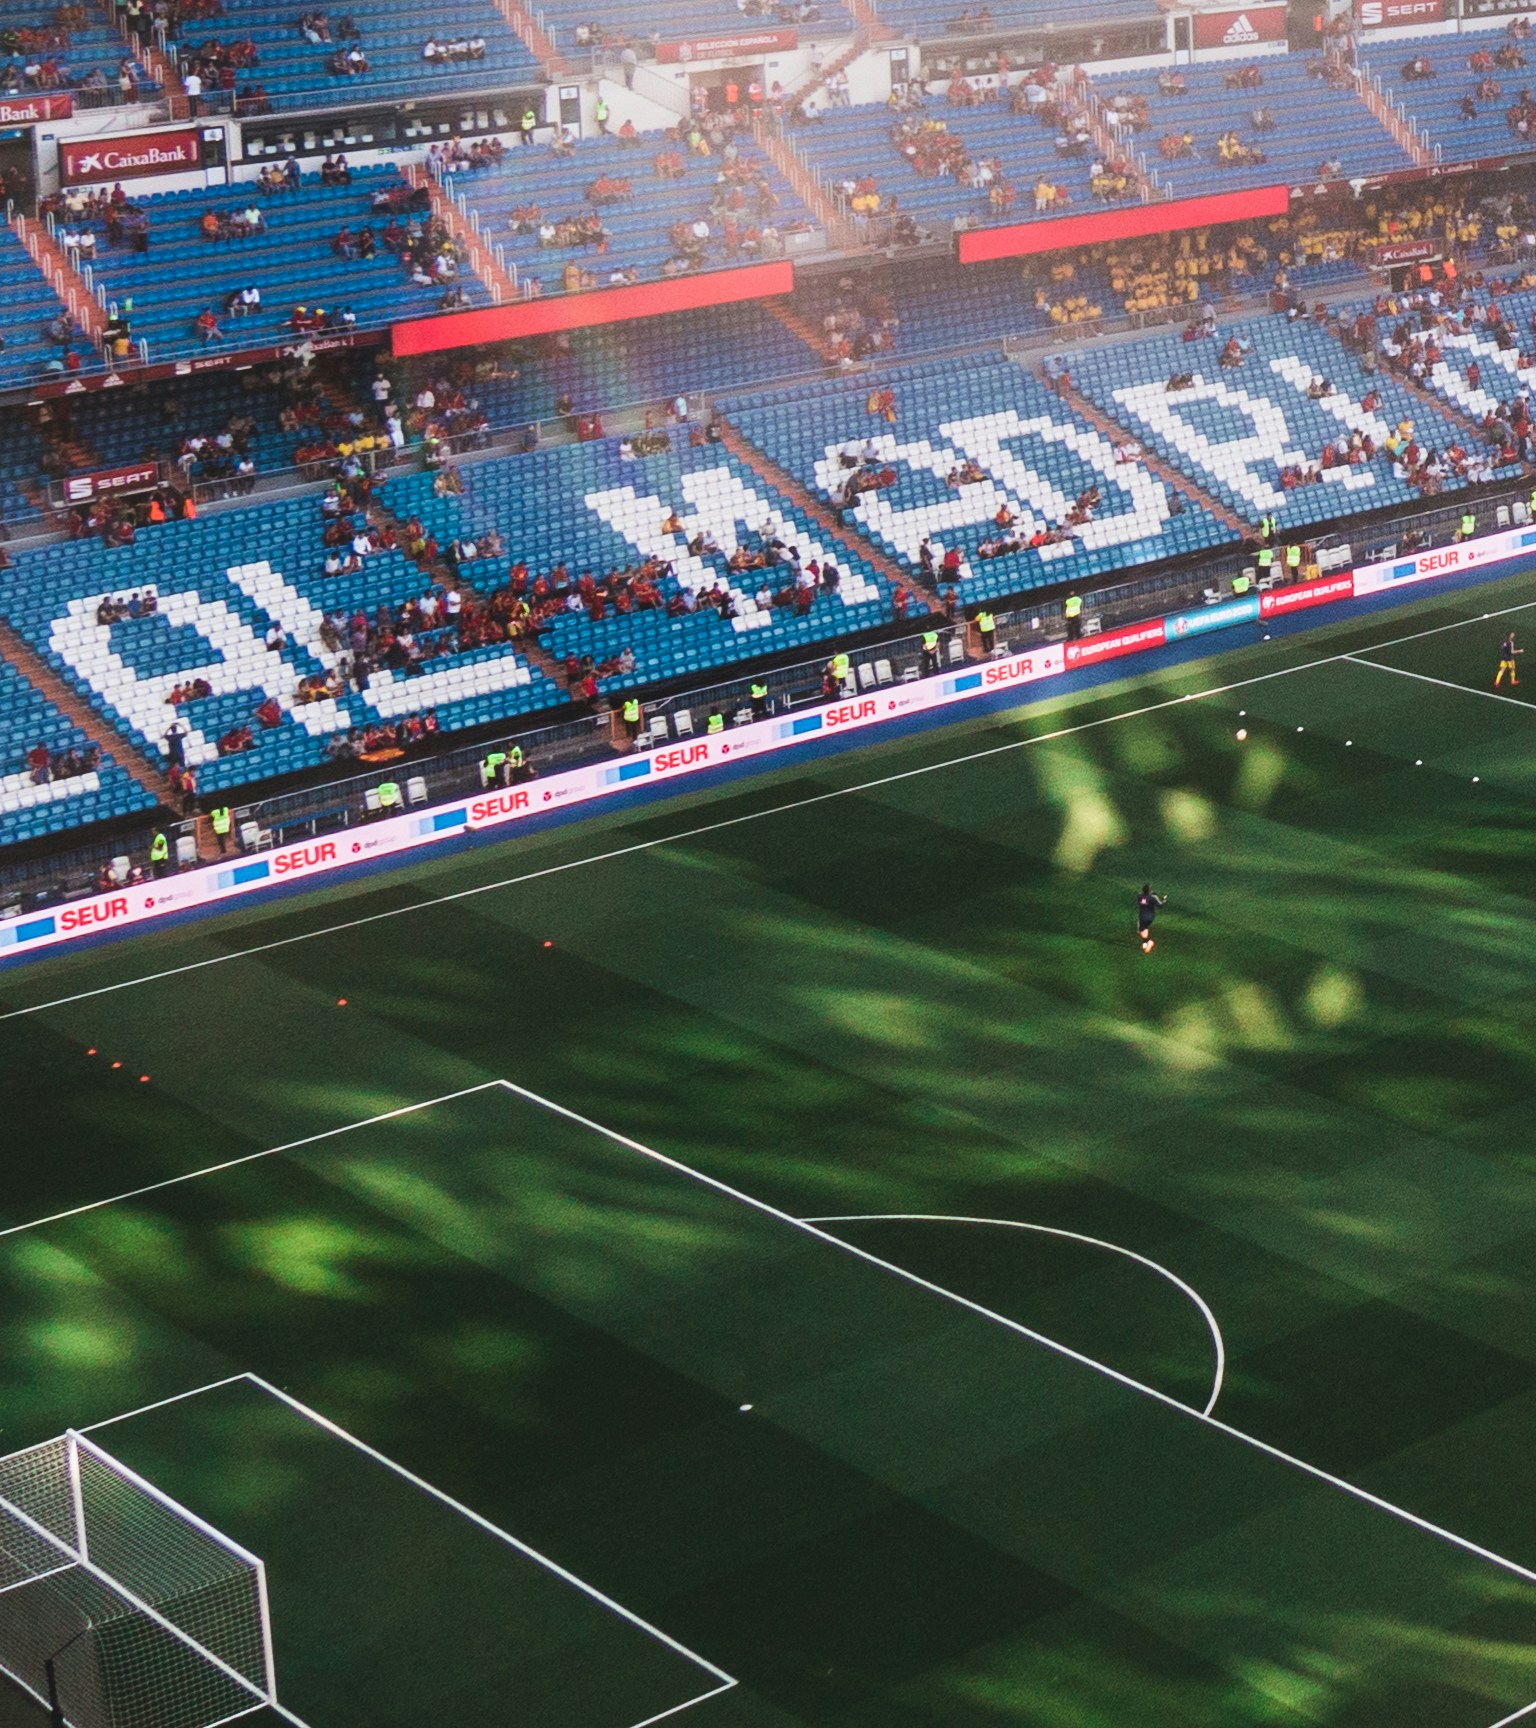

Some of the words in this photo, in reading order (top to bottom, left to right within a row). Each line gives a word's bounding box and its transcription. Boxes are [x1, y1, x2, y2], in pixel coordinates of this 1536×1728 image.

[1387, 2, 1438, 17] SEAT
[1223, 31, 1259, 44] adidas
[104, 145, 186, 169] CaixaBank
[195, 356, 232, 369] SEAT
[97, 470, 154, 490] SEAT
[1419, 551, 1459, 573] SEUR
[1276, 589, 1313, 606] EUROPEAN
[1313, 579, 1352, 597] QUALIFIERS
[1081, 638, 1121, 658] EUROPEAN
[1122, 627, 1164, 647] QUALIFIERS
[986, 659, 1033, 685] SEUR
[826, 700, 876, 727] SEUR
[654, 744, 709, 772] SEUR
[471, 791, 529, 821] SEUR
[274, 842, 336, 874] SEUR
[60, 897, 128, 931] SEUR
